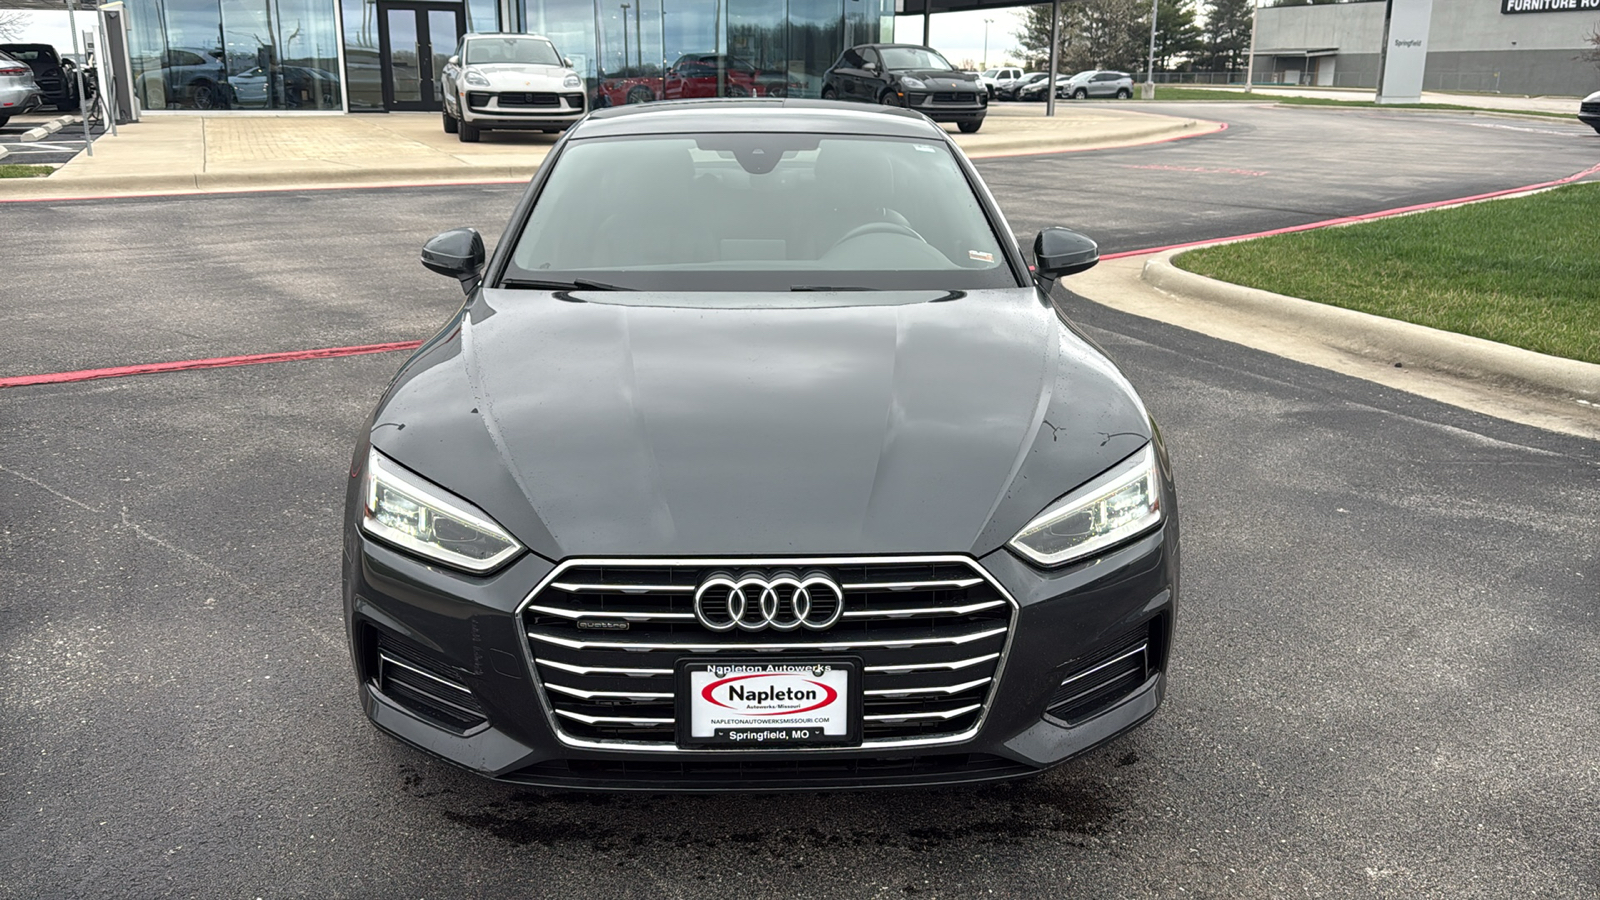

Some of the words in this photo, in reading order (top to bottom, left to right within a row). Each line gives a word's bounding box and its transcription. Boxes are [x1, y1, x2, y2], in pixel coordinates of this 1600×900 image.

[1507, 0, 1577, 11] FURNITURE
[1395, 39, 1422, 48] Springfield
[707, 665, 763, 673] Napleton
[766, 664, 831, 672] Autowerks
[729, 685, 817, 704] Napleton
[729, 731, 789, 741] Springfield,
[792, 730, 809, 738] MO
